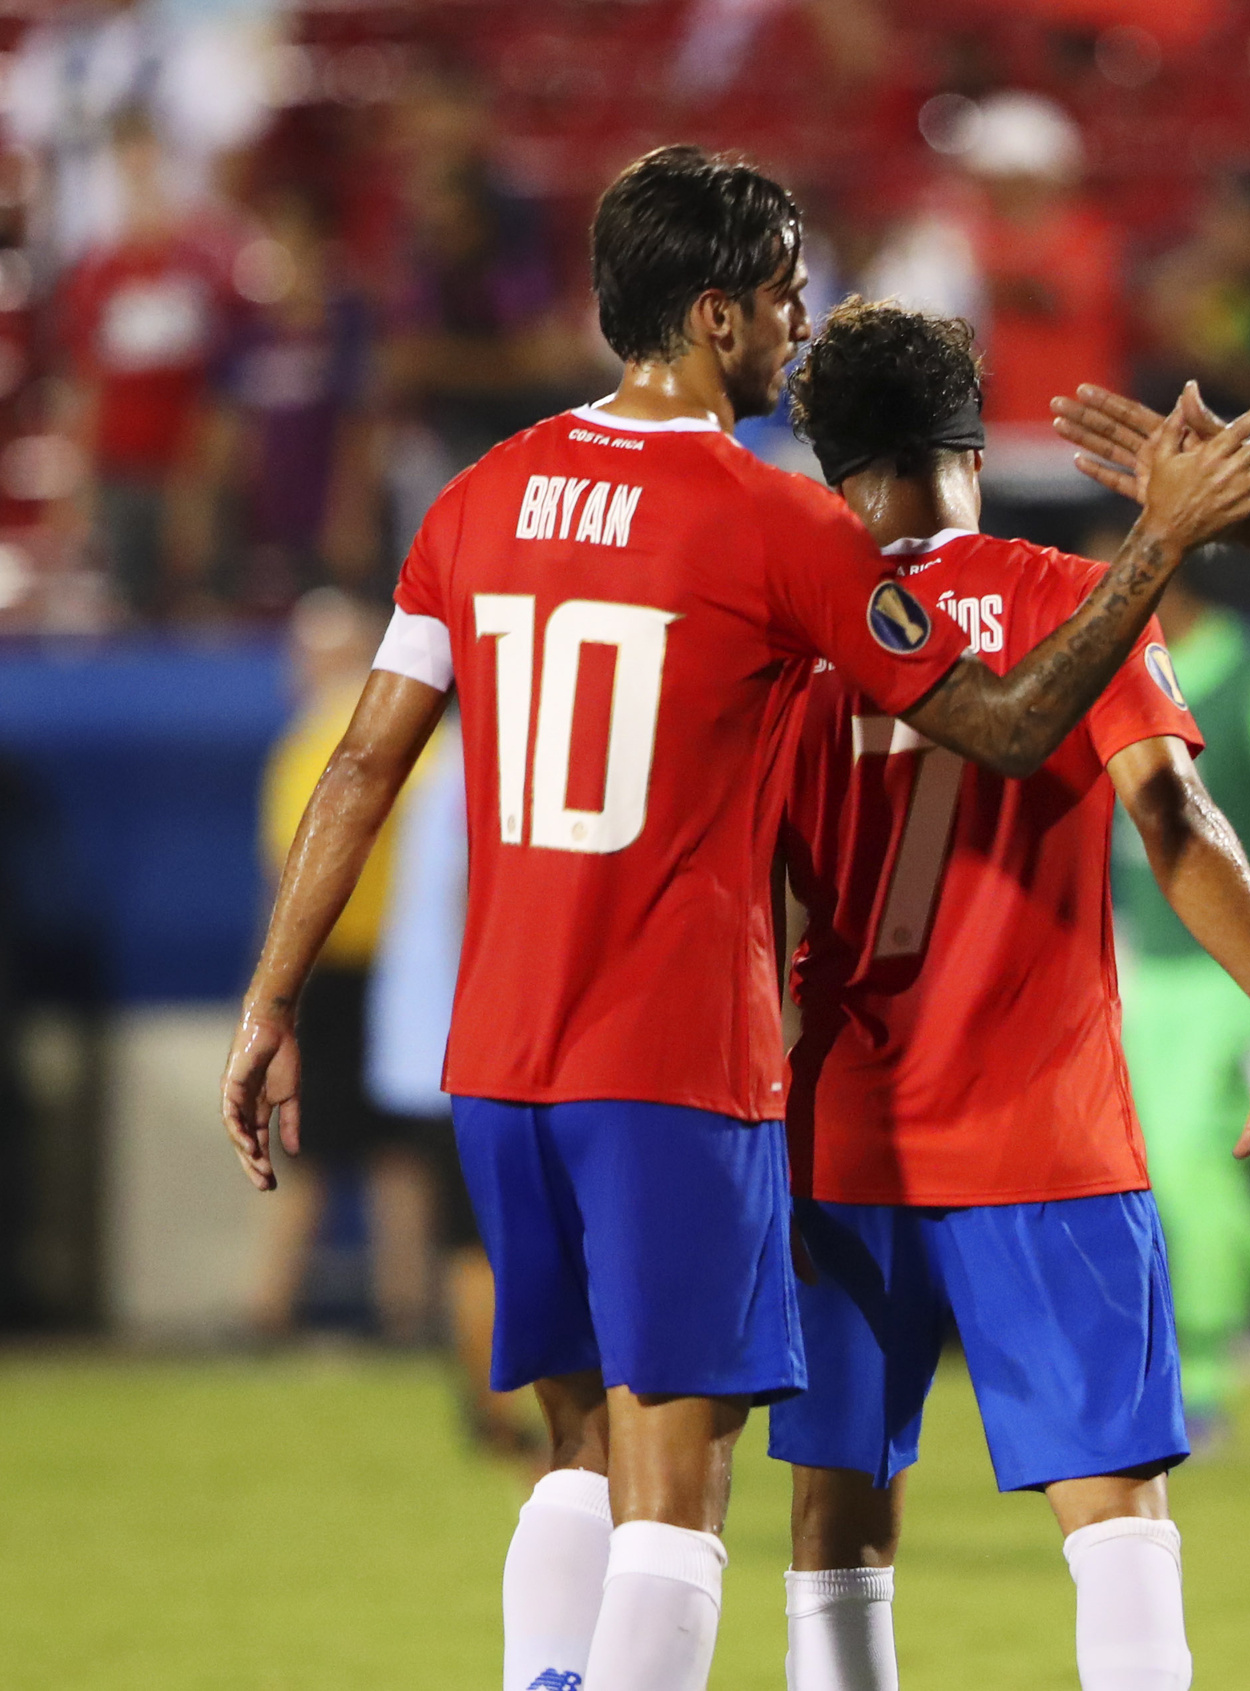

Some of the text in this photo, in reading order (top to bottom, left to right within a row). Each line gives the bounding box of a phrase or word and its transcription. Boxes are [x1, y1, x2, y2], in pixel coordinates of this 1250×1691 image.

[568, 428, 645, 451] COSTA RICA
[515, 474, 643, 548] BRYAN
[473, 593, 687, 854] 10
